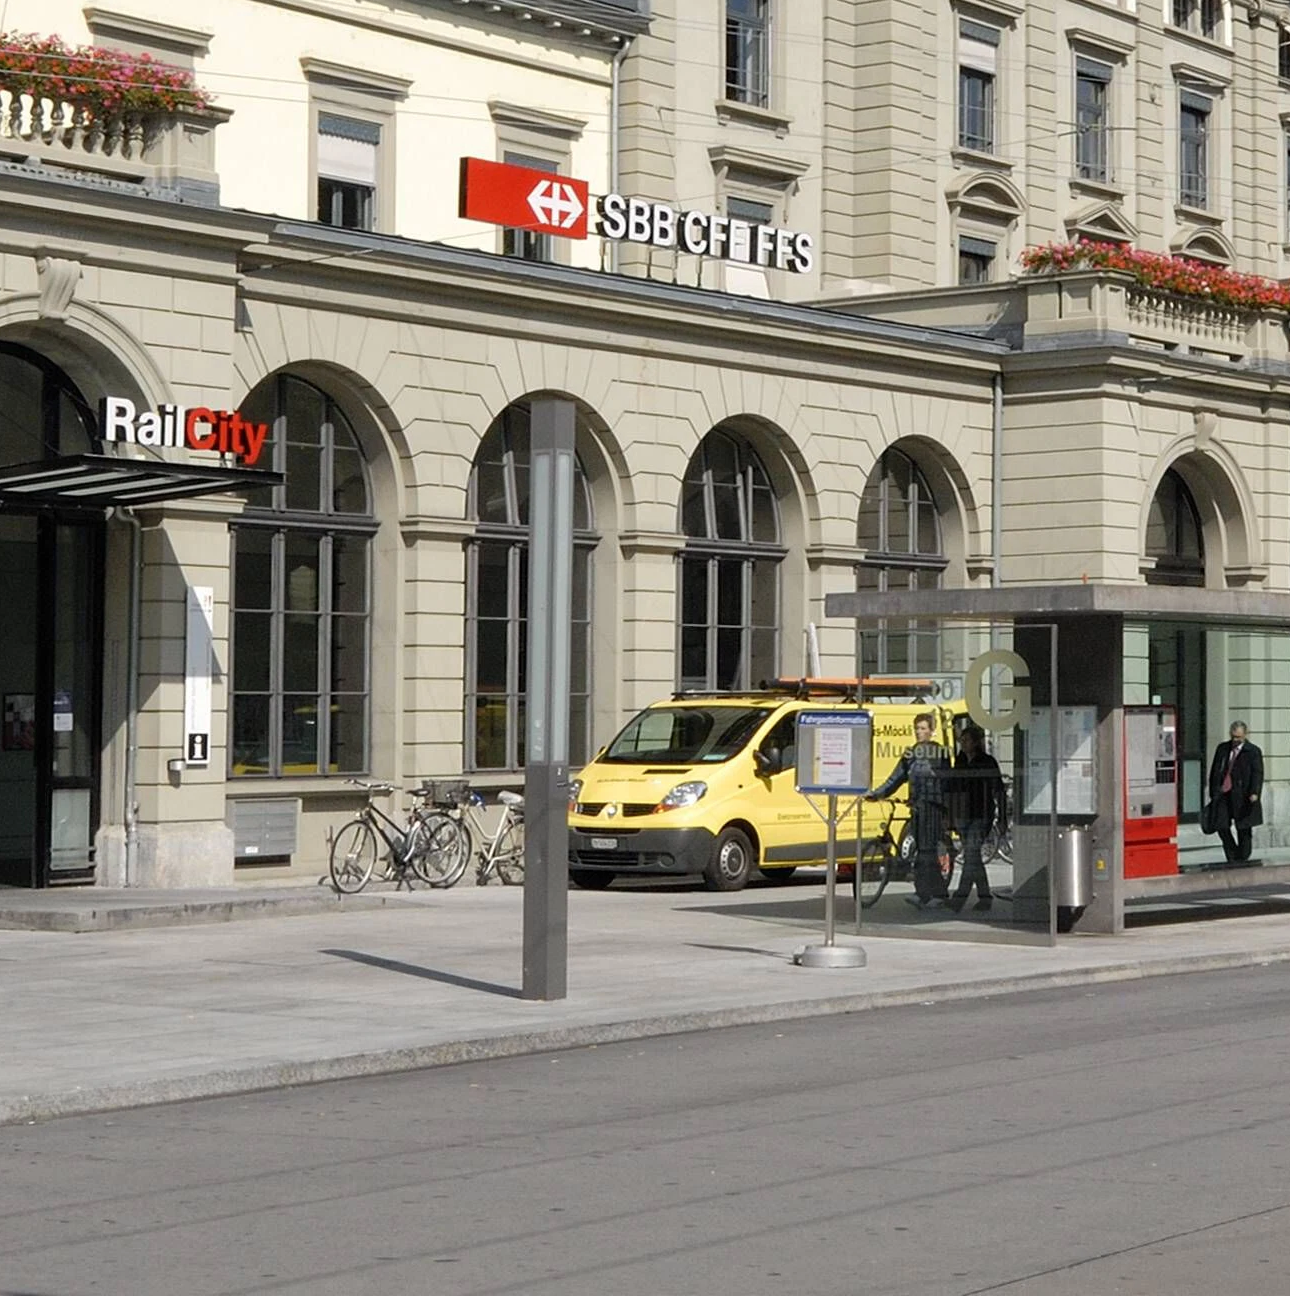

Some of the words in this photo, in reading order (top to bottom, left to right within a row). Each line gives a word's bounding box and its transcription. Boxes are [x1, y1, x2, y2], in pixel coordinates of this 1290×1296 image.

[602, 193, 675, 247] SBB
[683, 210, 750, 263] CFF
[756, 224, 814, 274] FFS
[105, 396, 269, 465] RailCity
[964, 648, 1032, 733] G
[875, 741, 955, 760] Museum
